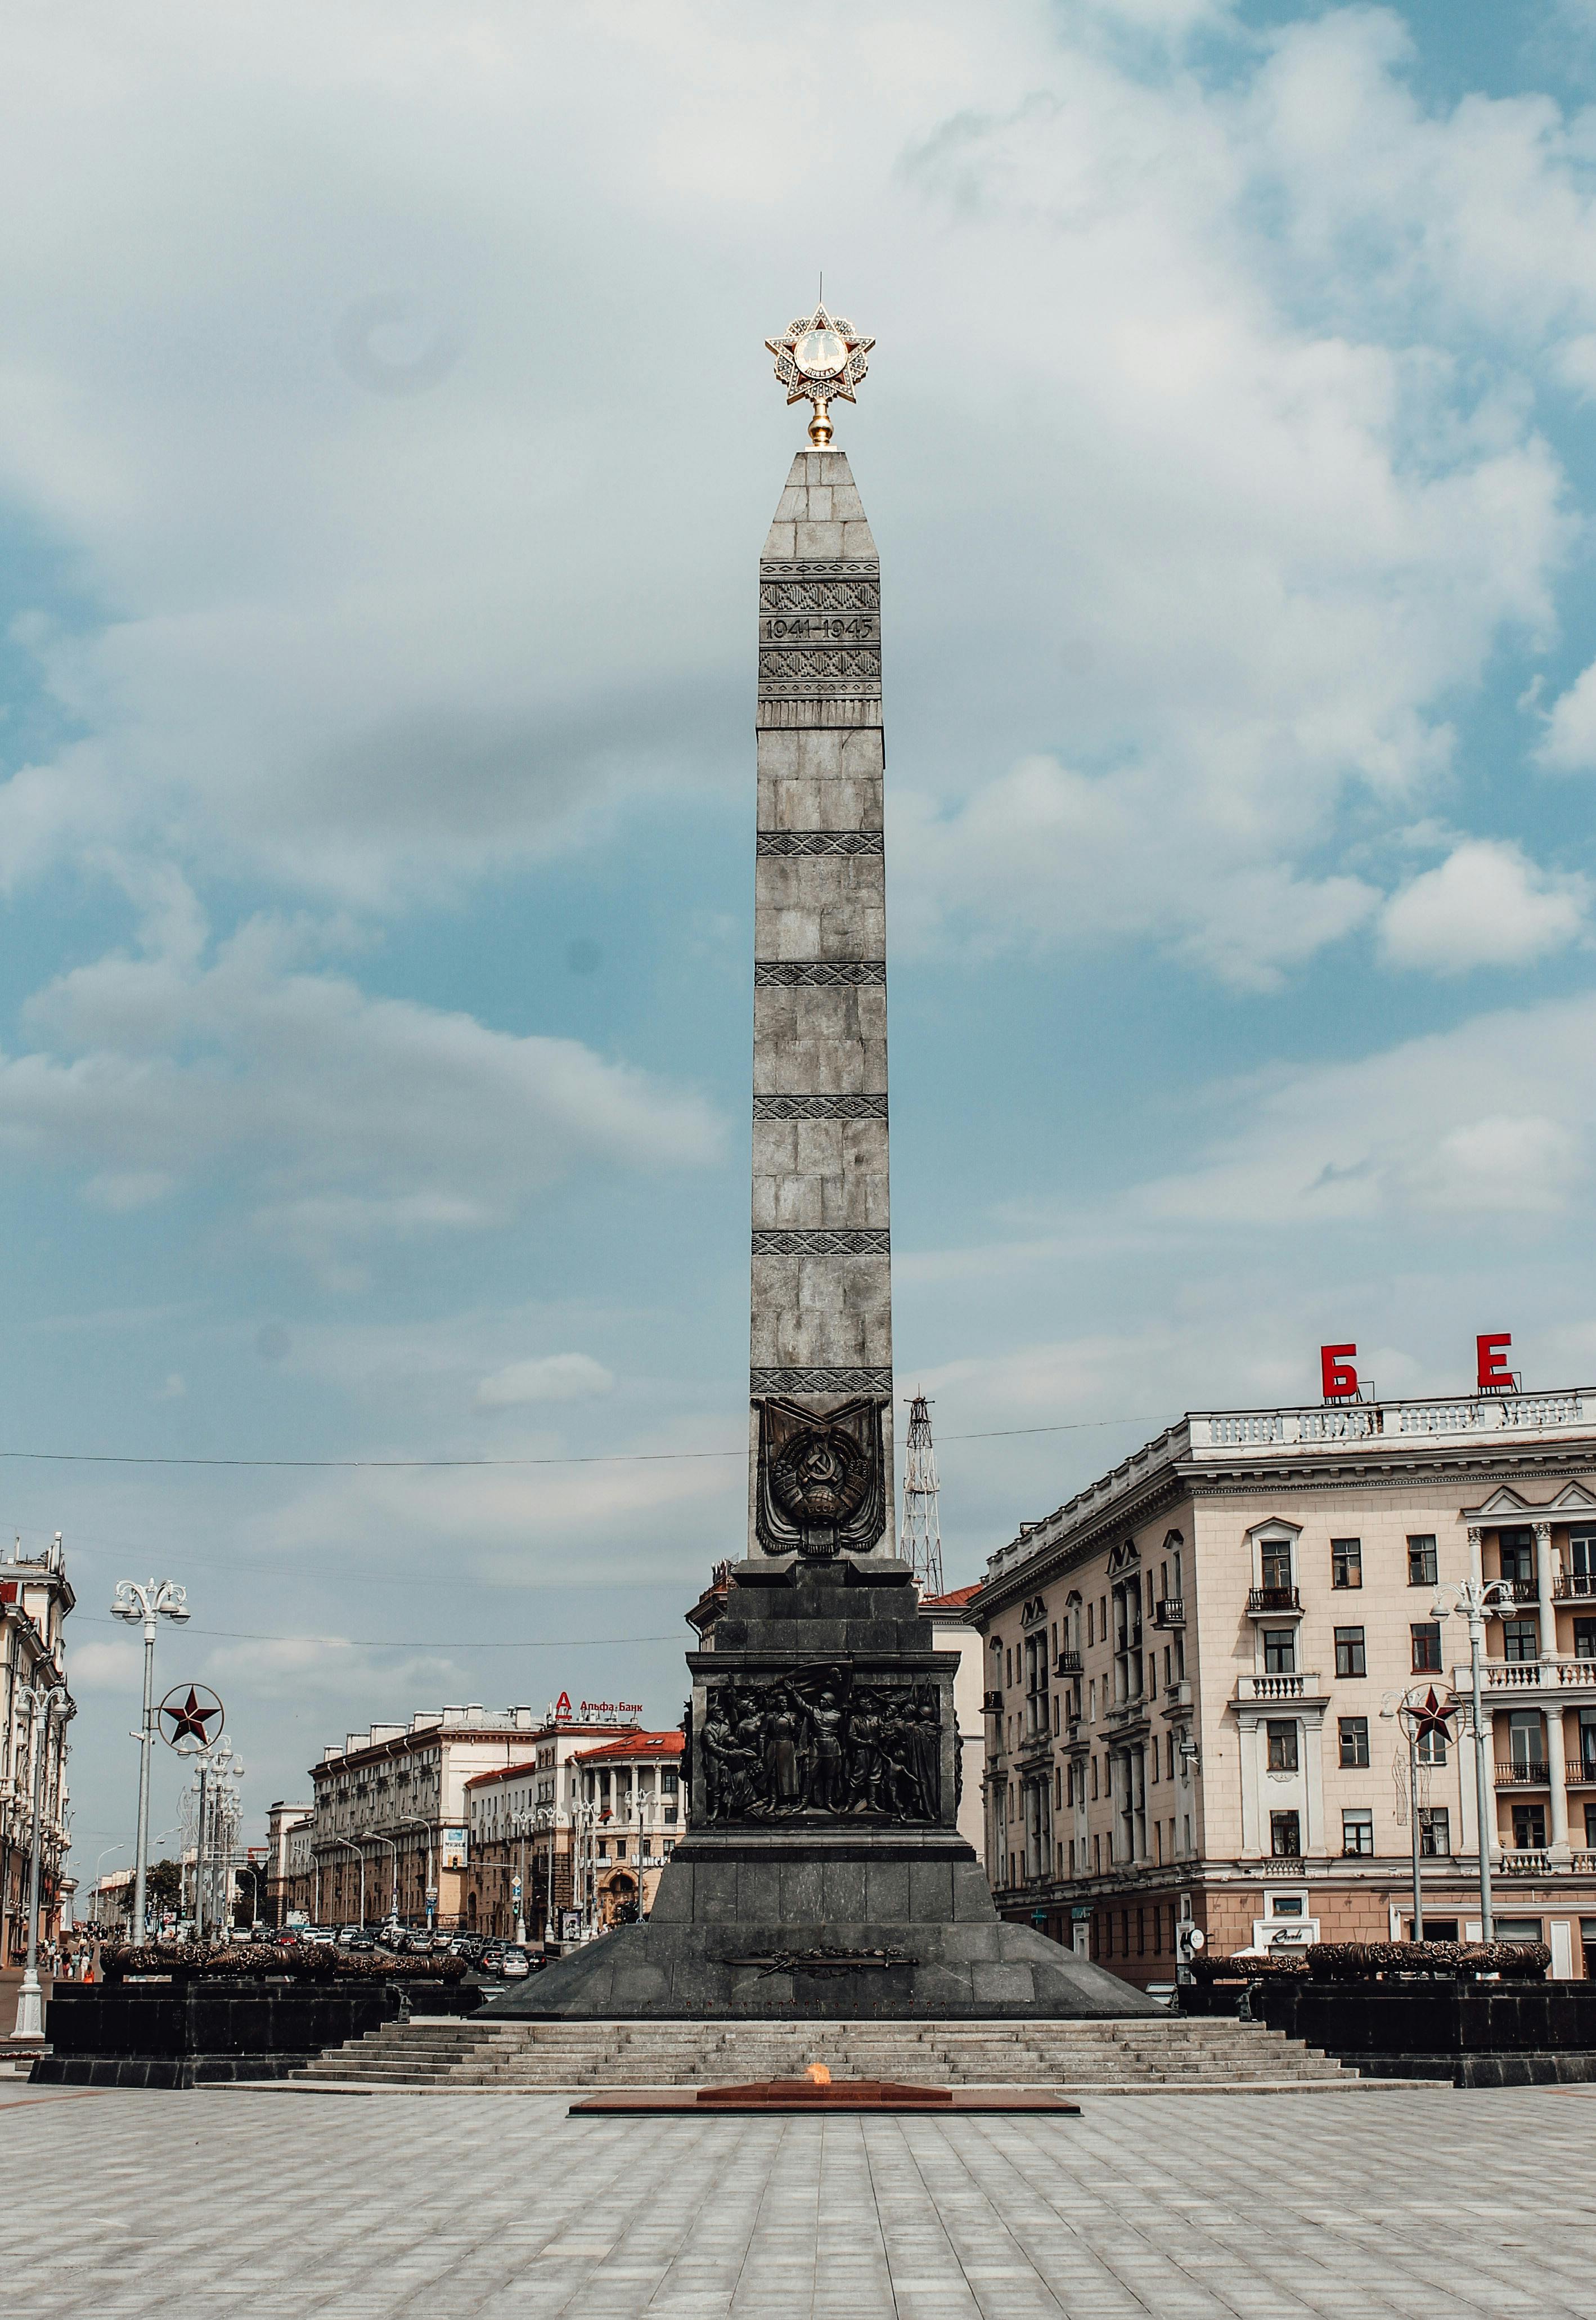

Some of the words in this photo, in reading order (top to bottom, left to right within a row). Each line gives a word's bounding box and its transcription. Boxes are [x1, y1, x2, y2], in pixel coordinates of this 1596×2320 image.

[806, 367, 835, 376] ПОБЕДА
[766, 618, 873, 639] 1941-1945
[807, 1504, 836, 1514] БССР
